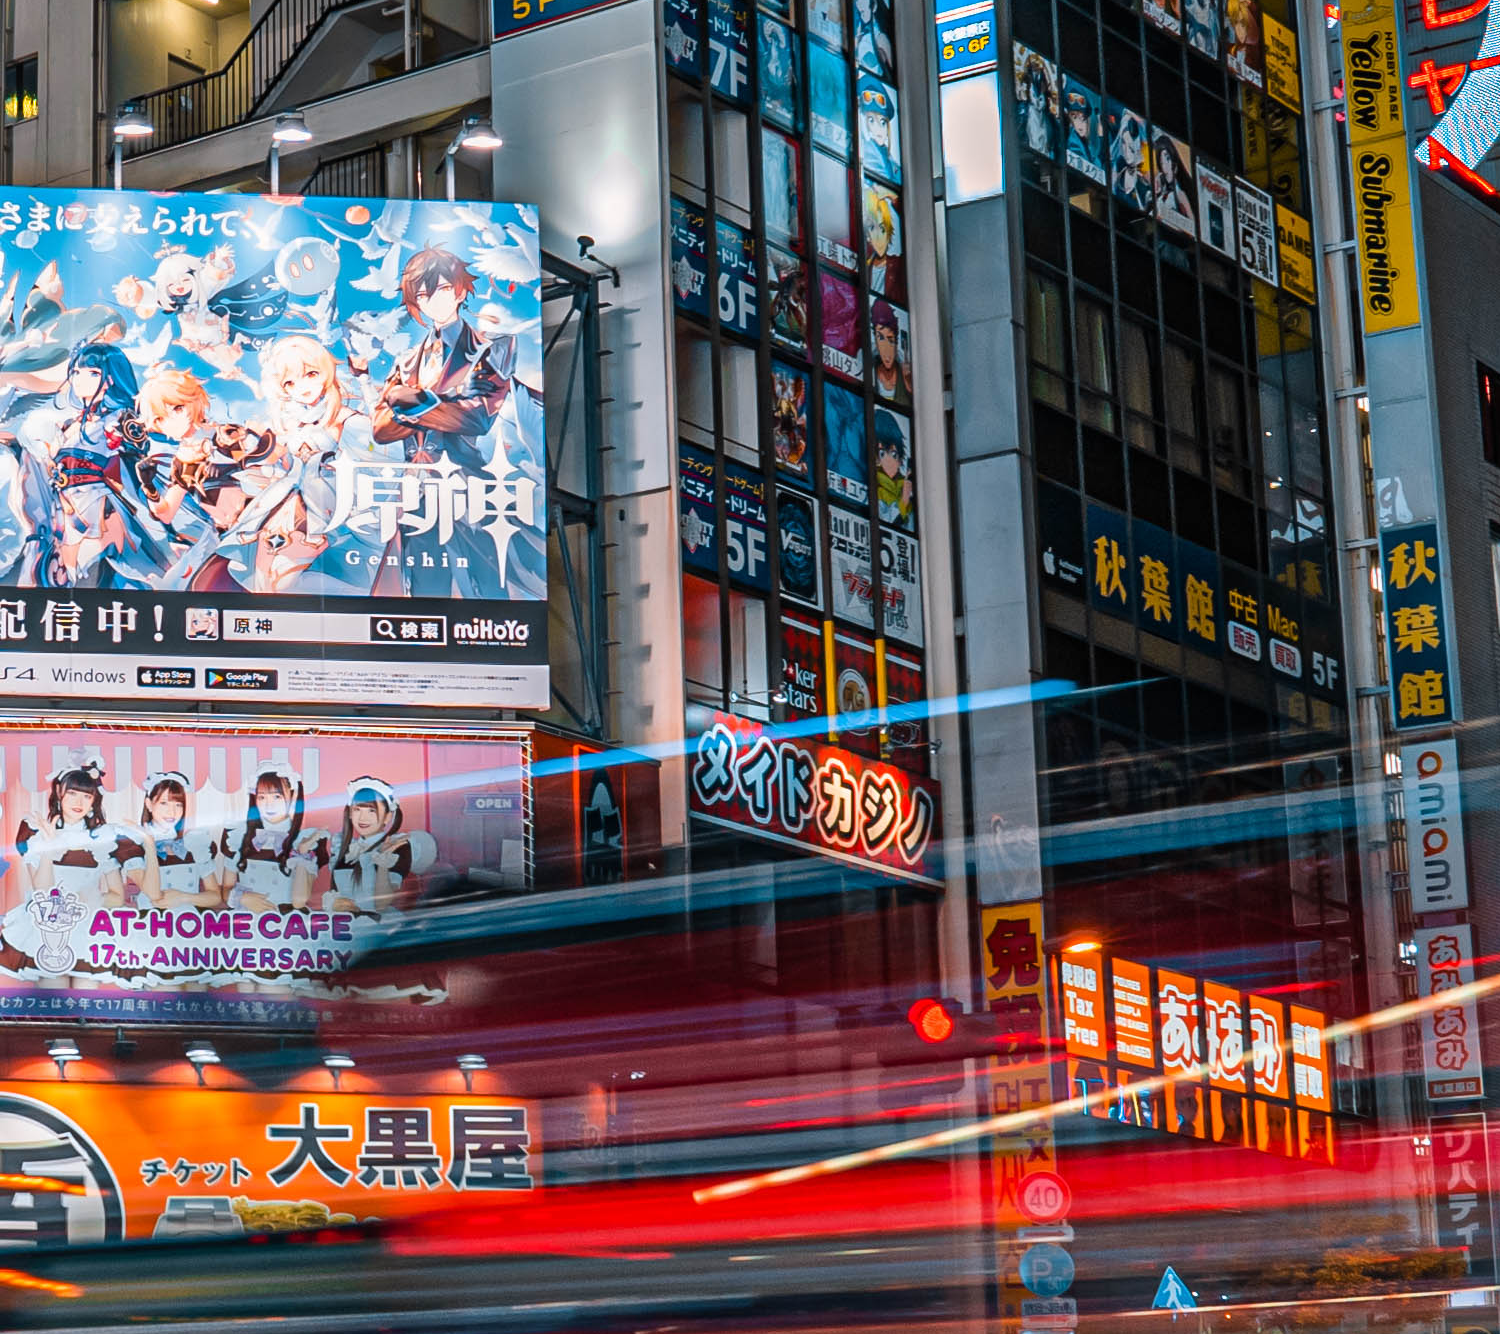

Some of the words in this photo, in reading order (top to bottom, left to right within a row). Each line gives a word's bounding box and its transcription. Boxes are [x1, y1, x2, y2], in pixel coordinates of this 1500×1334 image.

[709, 38, 748, 98] 7F
[1383, 31, 1395, 78] HOBBY
[1346, 30, 1382, 133] Yellow
[1387, 84, 1400, 122] BASE
[1357, 150, 1394, 317] Submarine
[718, 272, 756, 329] 6F
[328, 437, 536, 588] 原神
[345, 549, 471, 570] Genshin
[726, 519, 766, 577] 5F
[1092, 534, 1217, 642] 秋葉館
[233, 616, 273, 635] 原神
[400, 621, 439, 640] 検索
[453, 617, 531, 642] miHoYo
[1228, 587, 1259, 627] 中古
[1266, 603, 1300, 643] Mac
[1388, 540, 1448, 719] 秋葉館
[52, 668, 127, 685] Windows
[154, 670, 171, 682] App
[172, 670, 193, 681] Store
[226, 671, 250, 684] Google
[251, 673, 270, 686] Play
[1312, 651, 1339, 691] 5F
[475, 797, 513, 811] OPEN
[694, 722, 936, 865] メイドカジノ
[1416, 750, 1453, 904] amiami
[88, 907, 253, 941] AT-HOME
[257, 910, 354, 942] CAFE
[149, 946, 354, 971] ANNIVERSARY
[1066, 991, 1095, 1019] Tax
[1065, 1019, 1100, 1048] Free
[266, 1103, 534, 1192] 大黒屋
[141, 1158, 252, 1187] チケット
[1028, 1185, 1059, 1210] 40
